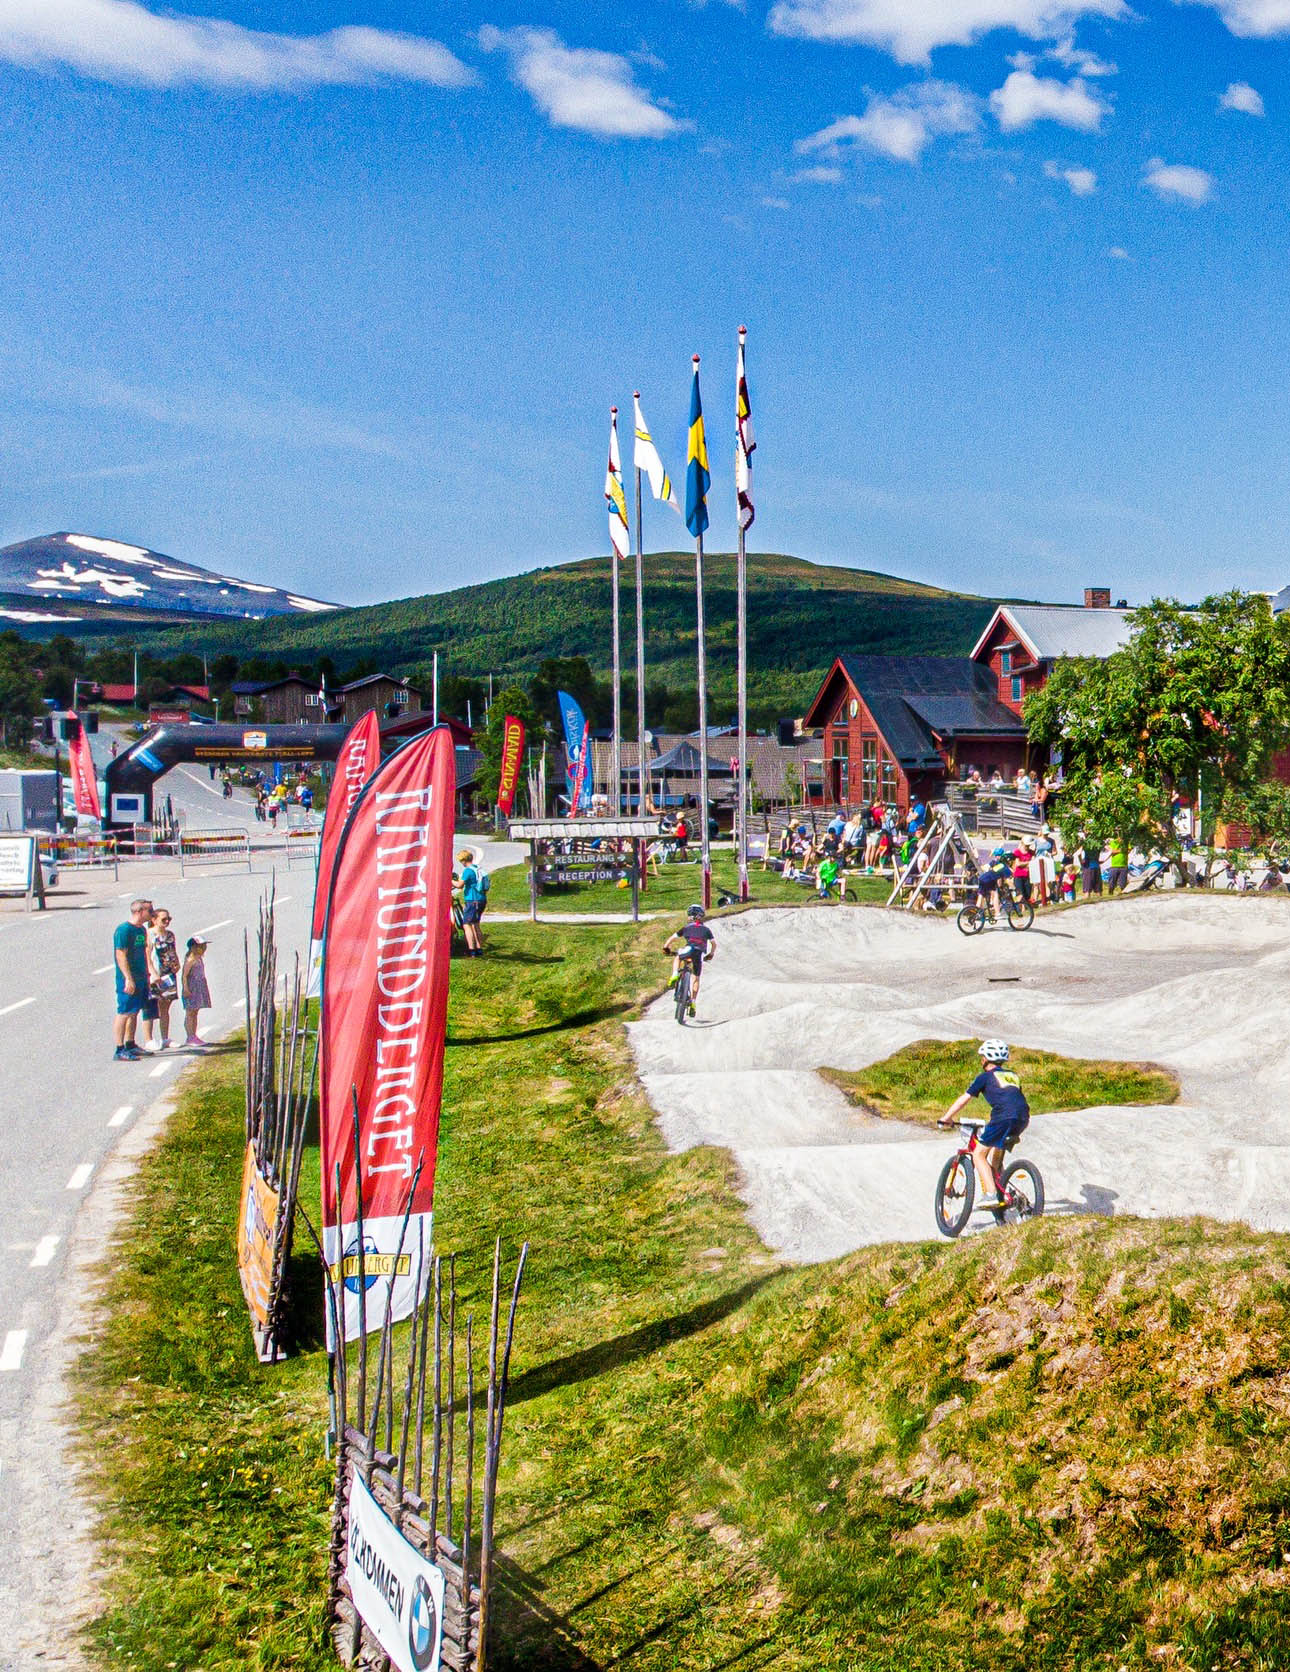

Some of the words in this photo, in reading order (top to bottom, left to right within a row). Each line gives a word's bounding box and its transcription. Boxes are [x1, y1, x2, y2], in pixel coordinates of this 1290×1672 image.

[554, 854, 614, 864] RESTAURANG
[558, 871, 613, 880] RECEPTION
[367, 784, 432, 1178] RAMUNDBERGET
